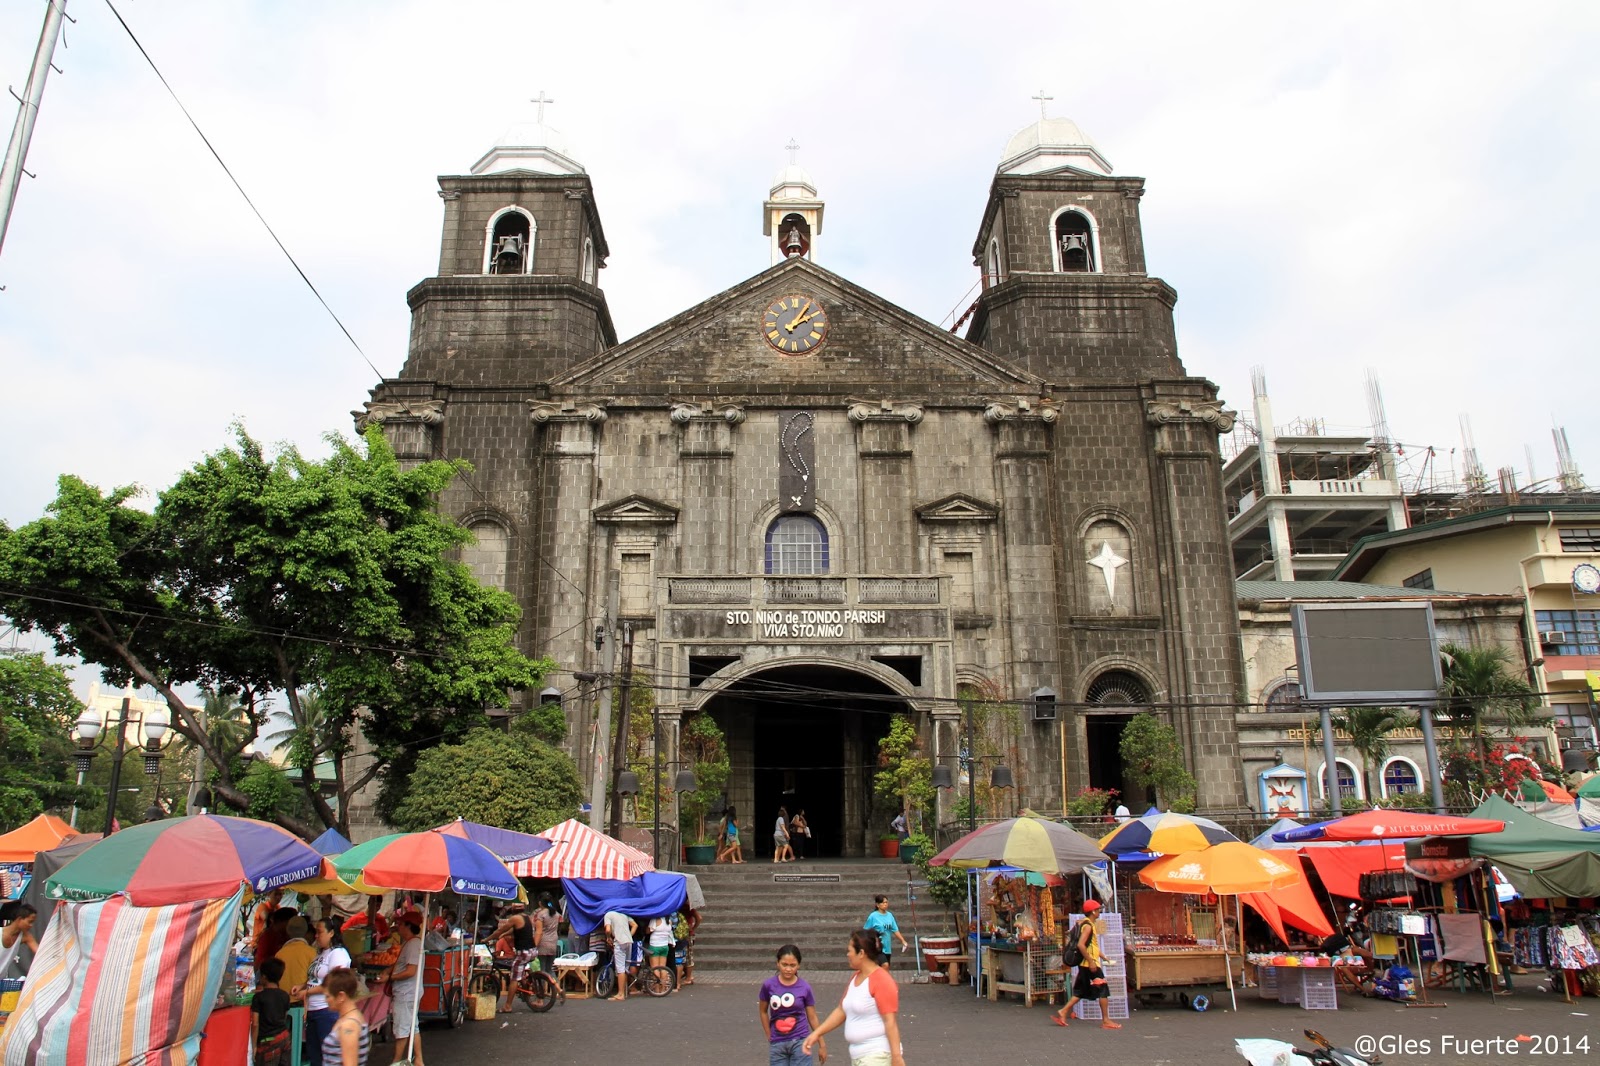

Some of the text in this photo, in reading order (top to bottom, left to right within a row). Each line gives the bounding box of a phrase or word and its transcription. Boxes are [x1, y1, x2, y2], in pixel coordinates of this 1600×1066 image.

[726, 610, 886, 625] STO. NIÑO de TONDO PARISH
[763, 624, 788, 637] VIVA
[1388, 823, 1459, 834] MICROMATIC
[268, 865, 318, 888] MICROMATIC
[1167, 870, 1207, 882] SUNTEX
